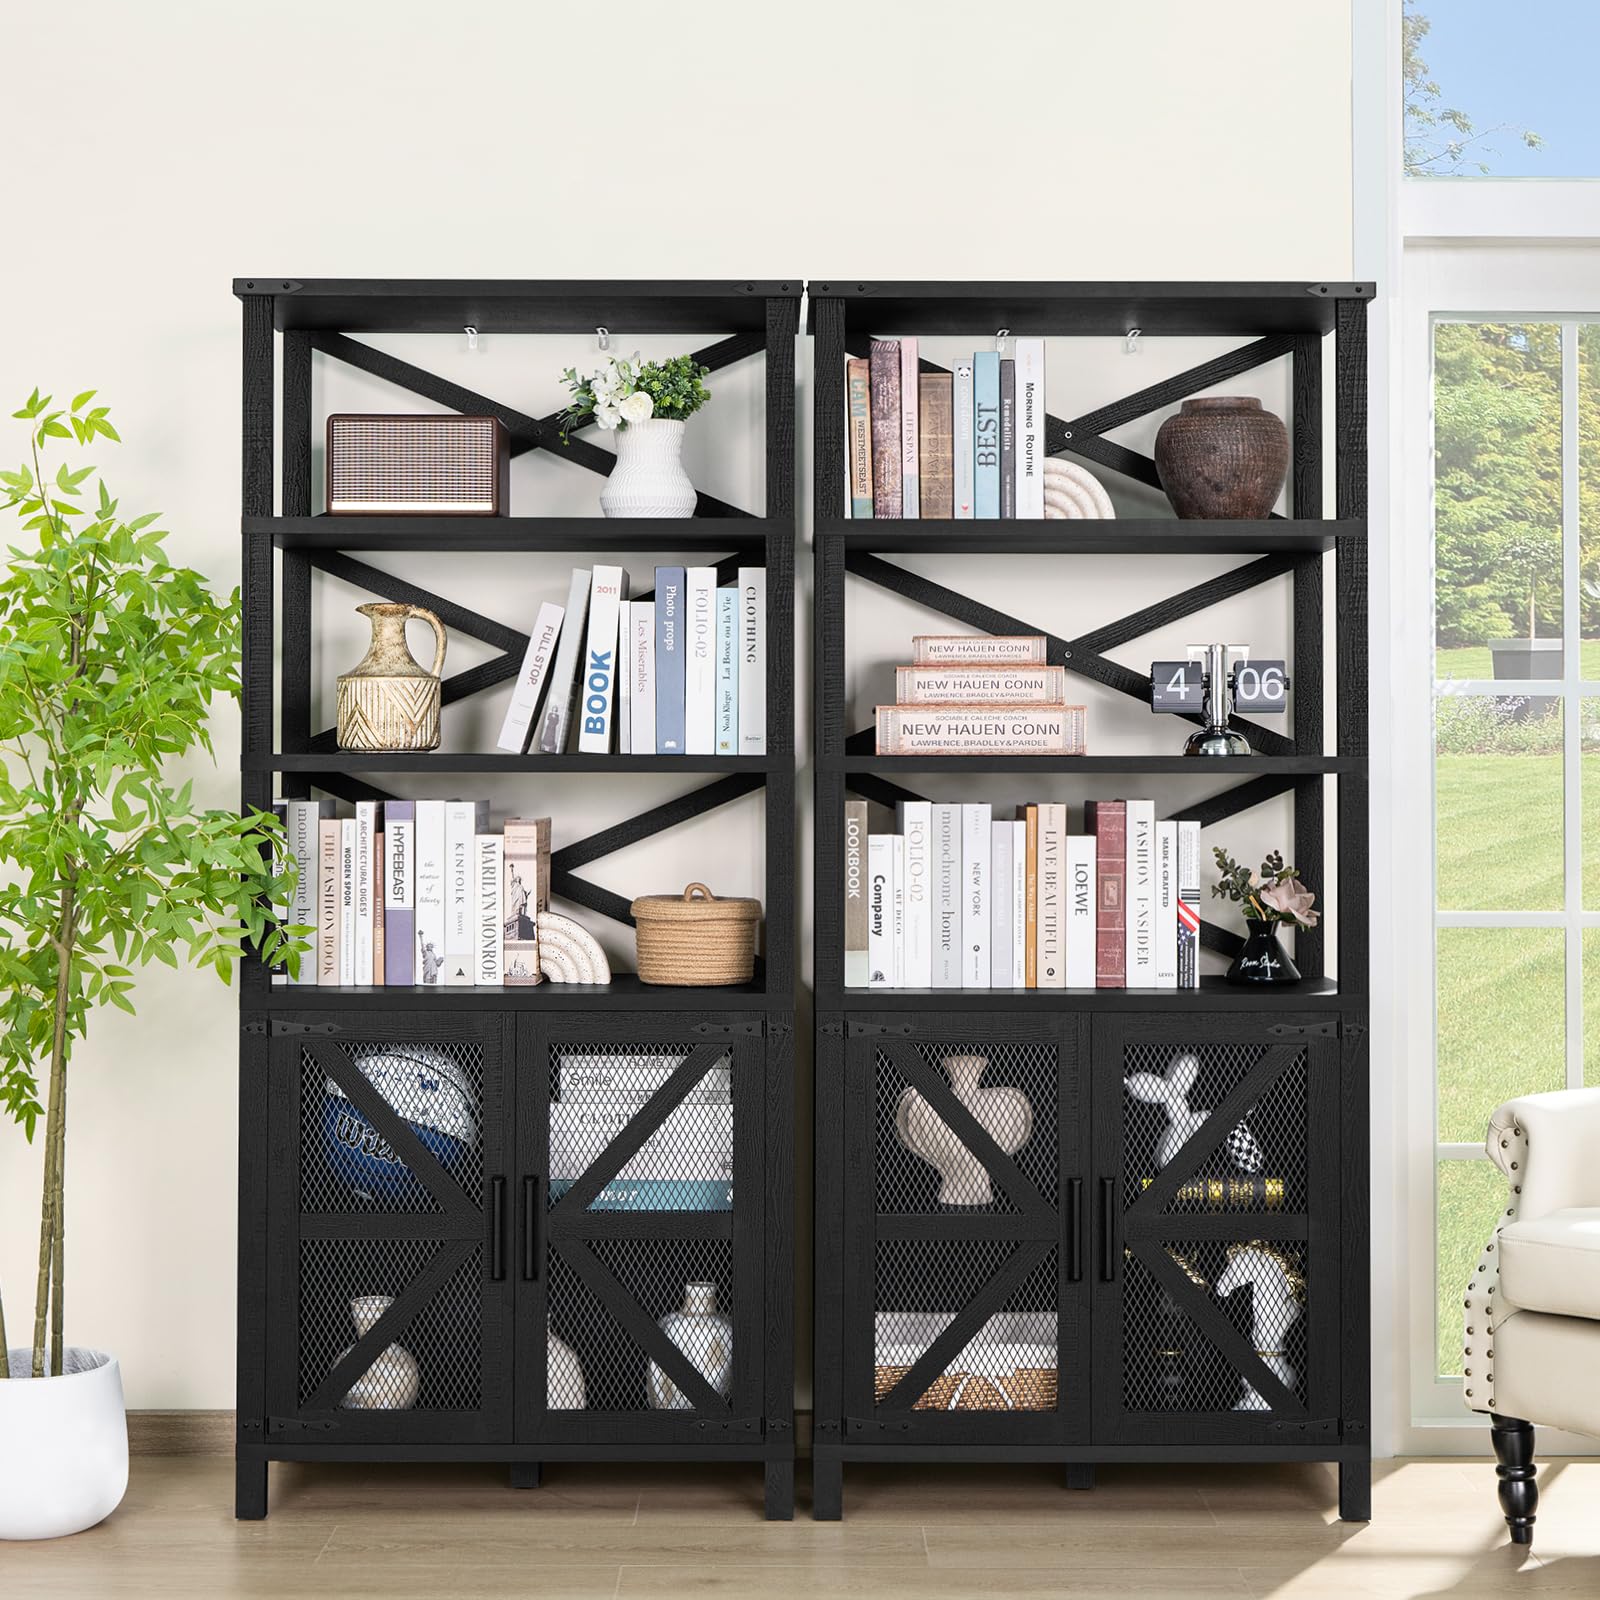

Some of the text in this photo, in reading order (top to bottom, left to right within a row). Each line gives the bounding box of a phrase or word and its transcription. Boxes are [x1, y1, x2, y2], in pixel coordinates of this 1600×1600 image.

[850, 379, 866, 416] CAM
[1003, 399, 1012, 450] Remodelista
[858, 420, 867, 494] WESTMEETSEAST
[906, 412, 914, 464] LIFESPAN
[977, 402, 997, 467] BEST
[596, 586, 616, 594] 2011
[664, 584, 677, 651] Photo props
[638, 620, 647, 637] Les
[695, 588, 708, 659] FOLIO-02
[722, 596, 730, 680] La Boxe ou la Vie
[746, 586, 756, 663] CLOTHING
[527, 626, 554, 686] FULL STOP.
[916, 680, 948, 690] NEW
[1004, 680, 1044, 690] CONN
[1166, 667, 1190, 700] 4
[1239, 667, 1284, 700] 06
[584, 650, 612, 735] BOOK
[722, 690, 731, 732] Noah Klieger
[902, 724, 942, 736] NEW
[1012, 724, 1060, 736] CONN
[298, 808, 310, 903] monochrome
[344, 847, 352, 879] WOODEN
[360, 820, 368, 886] ARCHITECTURAL
[392, 826, 404, 903] HYPEBEAST
[455, 843, 464, 904] KINFOLK
[847, 818, 860, 898] LOOKBOOK
[910, 820, 924, 903] FOLIO-02
[1045, 830, 1057, 866] LIVE
[1136, 820, 1148, 886] FASHION
[324, 832, 335, 976] THE FASHION BOOK
[344, 881, 352, 906] SPOON
[360, 888, 368, 917] DIGEST
[482, 842, 496, 980] MARILYN MONROE
[872, 874, 886, 937] Company
[942, 811, 955, 951] monochrome home
[972, 862, 980, 916] NEW YORK
[1075, 863, 1088, 916] LOEWE
[570, 1073, 612, 1086] Smile
